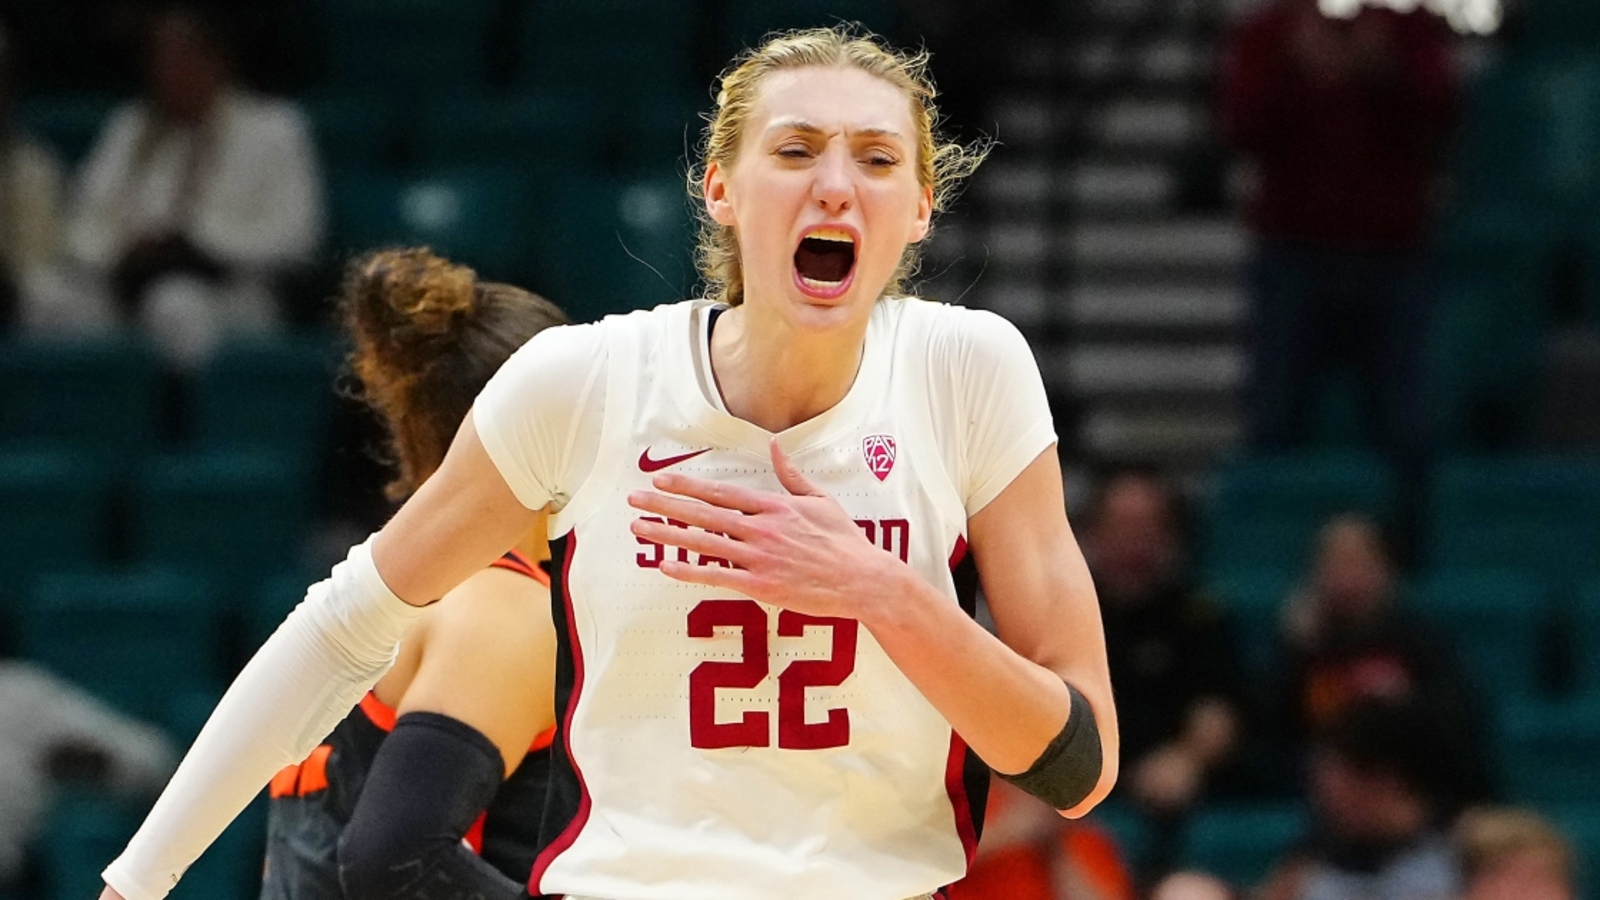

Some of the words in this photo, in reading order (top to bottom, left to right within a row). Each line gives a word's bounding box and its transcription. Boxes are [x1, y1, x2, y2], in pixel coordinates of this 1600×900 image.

[864, 435, 896, 462] PAC
[872, 454, 890, 472] 12
[636, 516, 909, 569] STAD
[687, 600, 858, 749] 22
